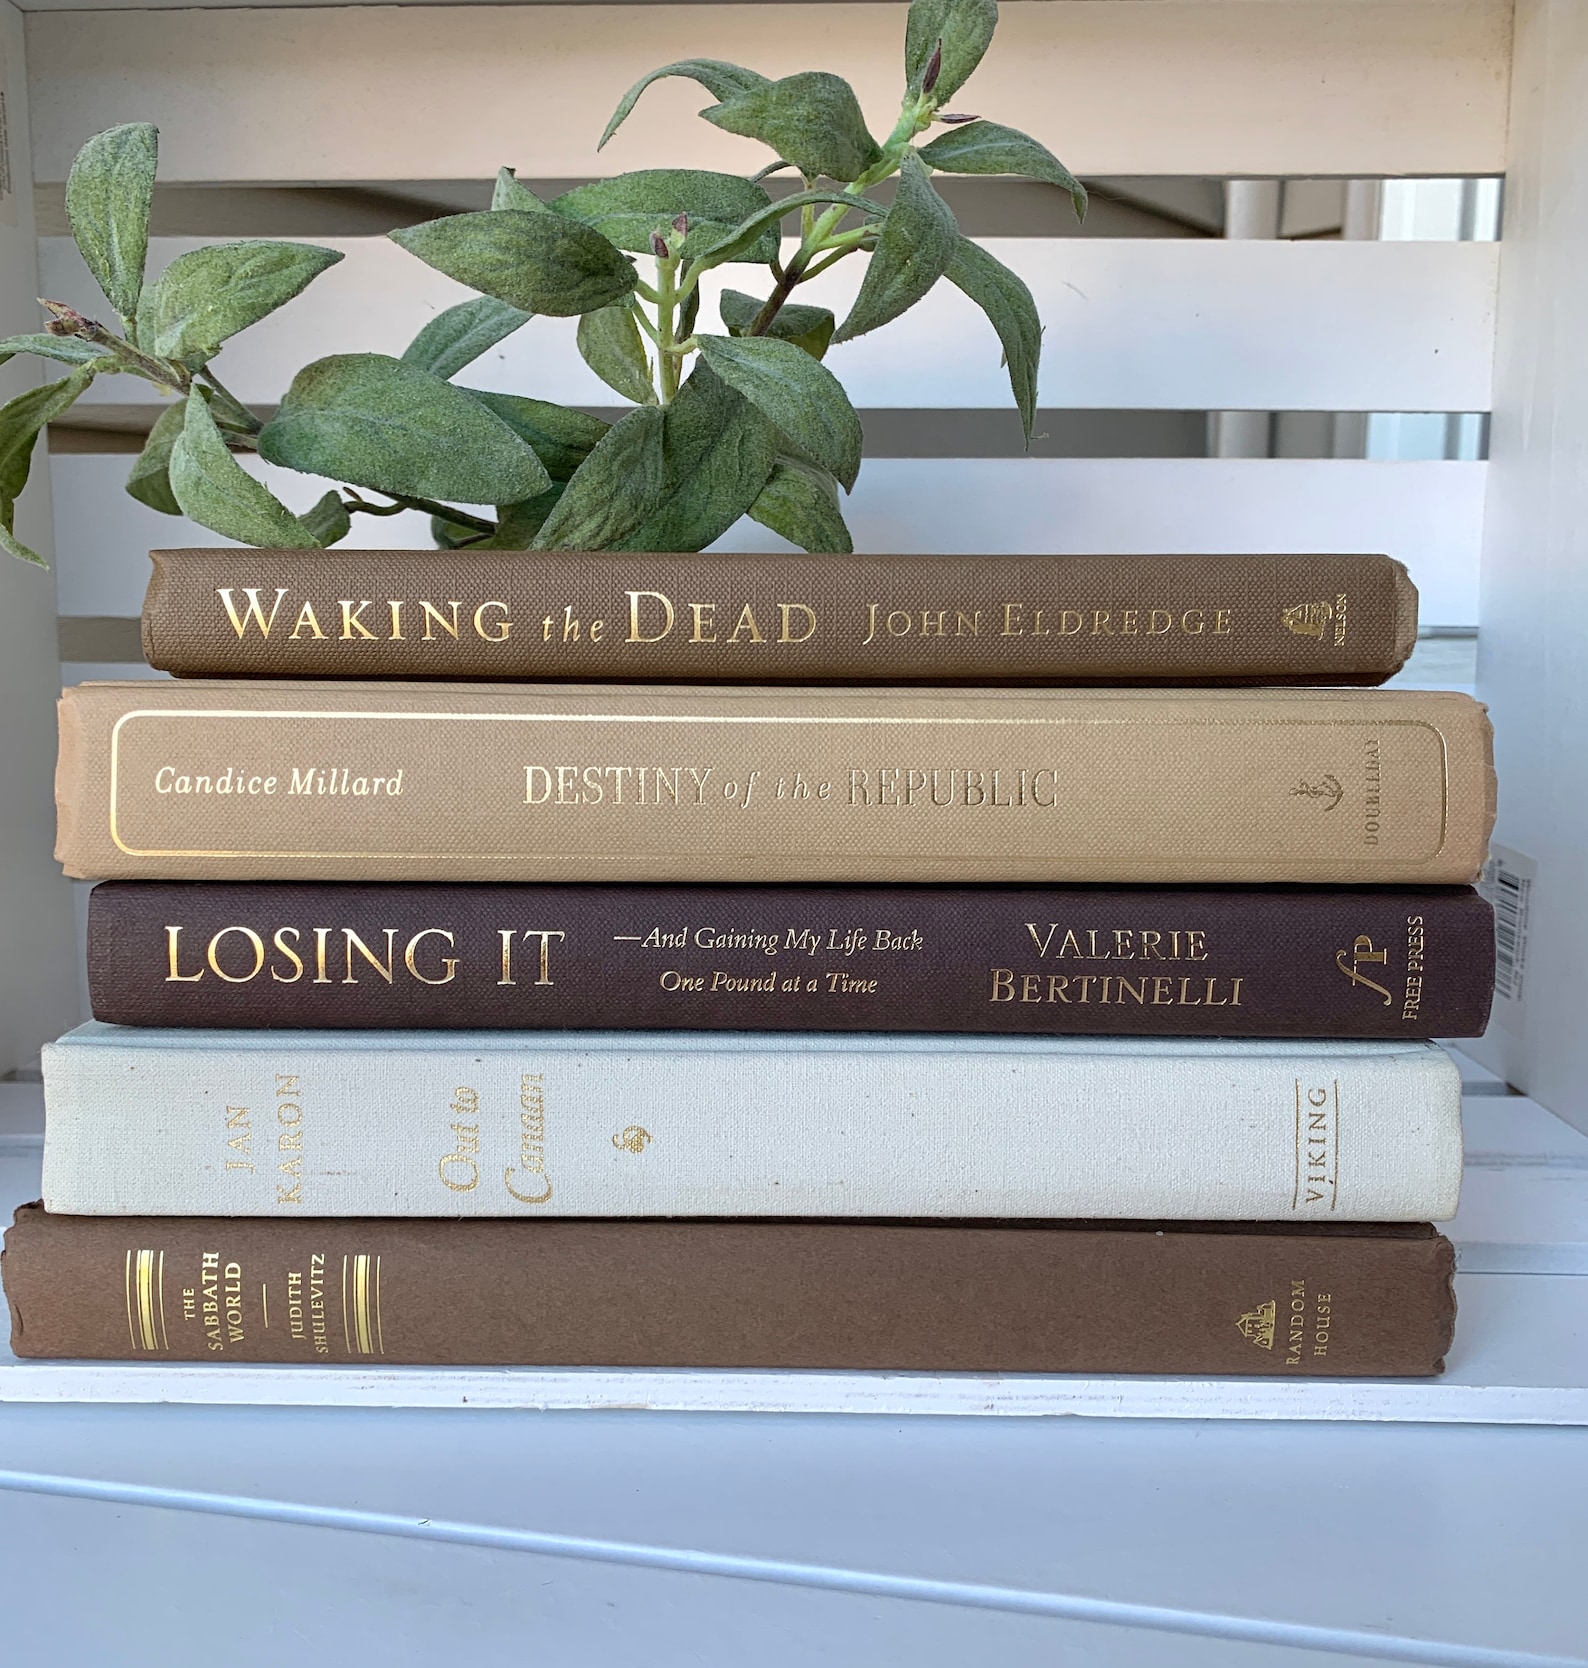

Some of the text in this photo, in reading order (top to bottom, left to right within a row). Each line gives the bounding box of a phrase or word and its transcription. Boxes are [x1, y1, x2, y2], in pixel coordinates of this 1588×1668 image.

[215, 587, 816, 644] WAKING the DEAD
[862, 603, 1233, 645] JOHN ELDREDGE
[1333, 593, 1347, 647] NELSON
[154, 766, 404, 797] Candice Millard
[522, 765, 1060, 809] DESTINY of the REPUBLIC
[1363, 736, 1380, 847] DOUBLEDAY
[164, 925, 565, 987] LOSING IT
[694, 927, 780, 956] Gaining
[783, 929, 822, 956] My
[826, 928, 868, 954] Life
[873, 928, 924, 952] Back
[1023, 922, 1210, 963] VALERIE
[1402, 915, 1424, 1020] FREE PRESS
[659, 970, 878, 995] One Pound at a Time
[989, 968, 1244, 1007] BERTINELLI
[226, 1107, 257, 1174] JAN
[276, 1073, 302, 1205] KARON
[438, 1086, 480, 1193] Out to
[504, 1073, 553, 1205] Canaan
[1306, 1087, 1327, 1204] VIKING
[183, 1288, 196, 1321] THE
[201, 1251, 223, 1352] SABBATH
[224, 1261, 245, 1344] WORLD
[287, 1271, 304, 1340] JUDITH
[311, 1253, 329, 1355] SHULEVITZ
[1286, 1279, 1306, 1367] RANDOM
[1313, 1293, 1332, 1356] HOUSE
